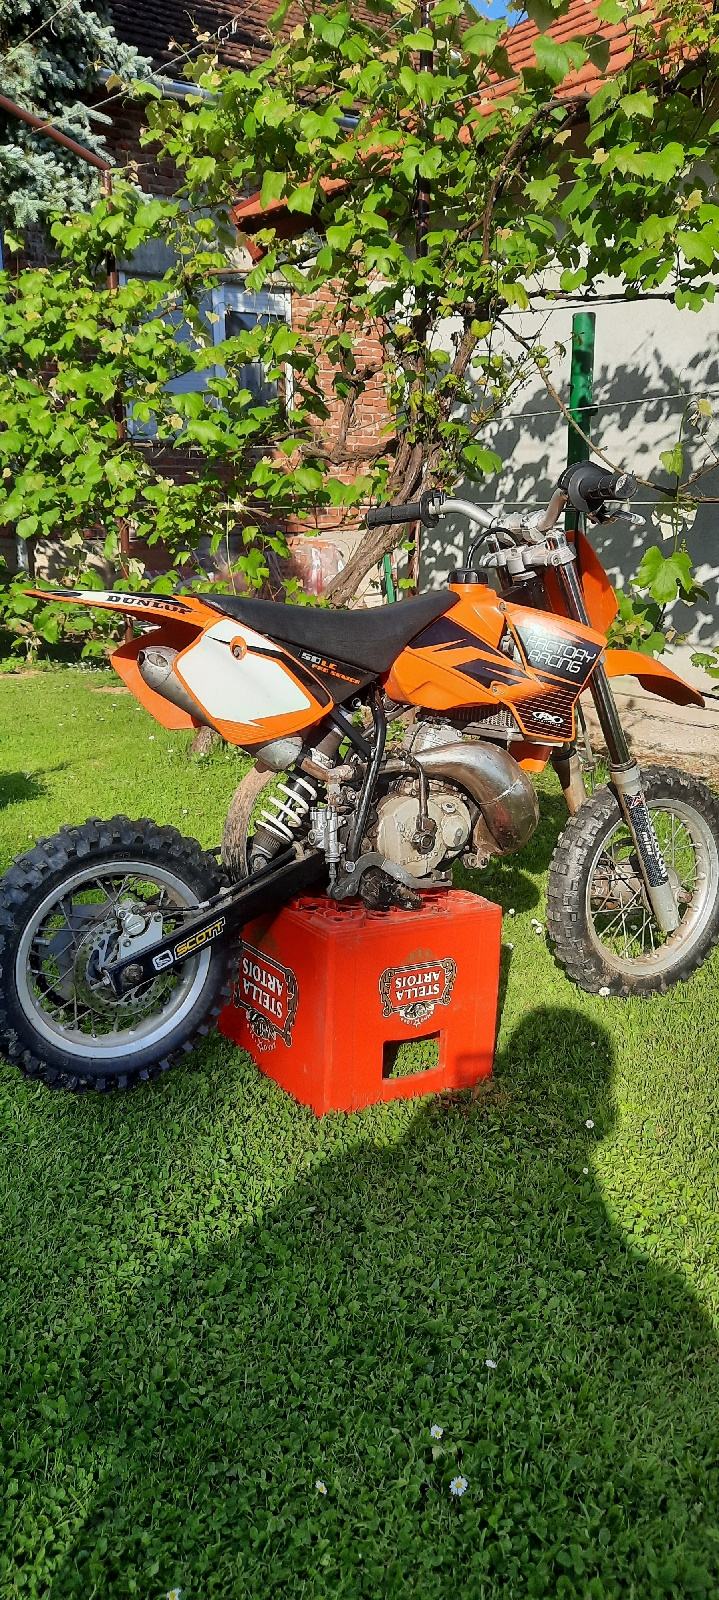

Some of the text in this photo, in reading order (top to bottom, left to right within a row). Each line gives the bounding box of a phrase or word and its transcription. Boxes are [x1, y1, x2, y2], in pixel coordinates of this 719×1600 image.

[105, 595, 192, 614] DUNLOP
[525, 635, 597, 663] FACTORY
[527, 650, 583, 674] RACING
[176, 920, 224, 957] SCOTT
[242, 957, 285, 997] ARTOIS
[395, 970, 442, 989] ARTOIS
[242, 977, 284, 1019] STELLA
[395, 983, 441, 1001] STELLA
